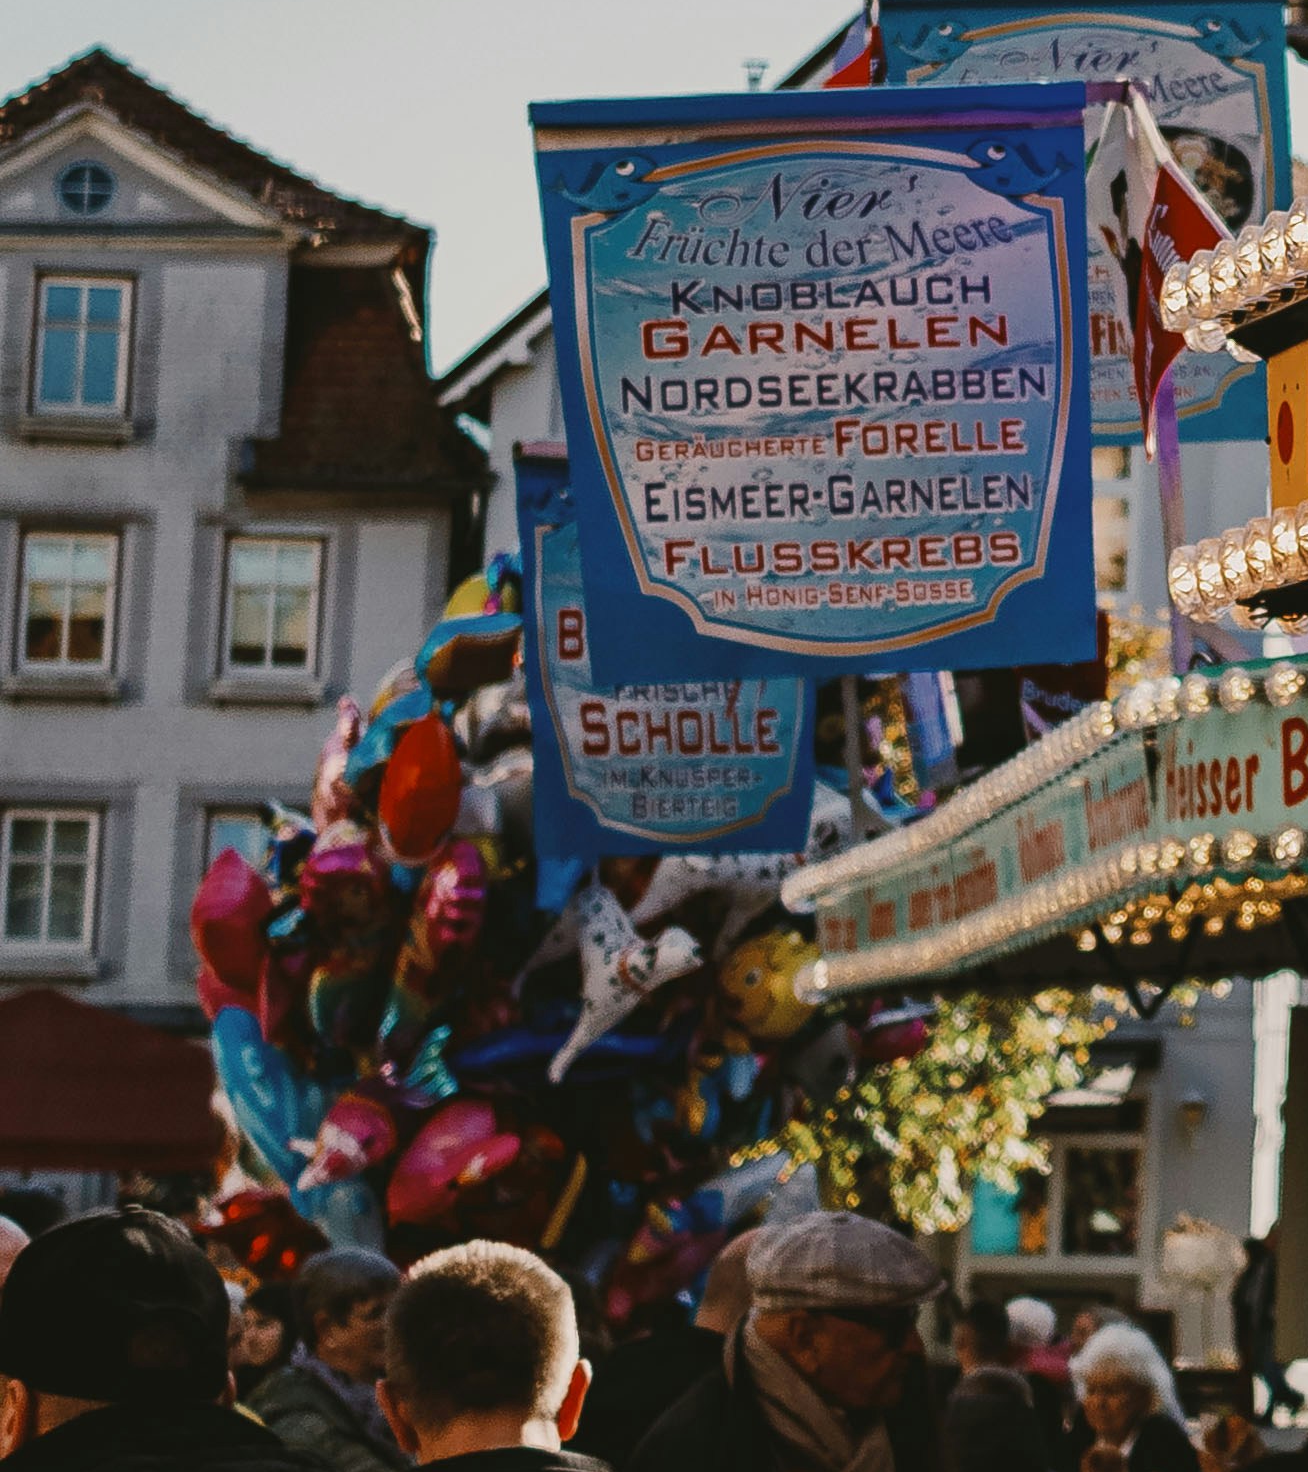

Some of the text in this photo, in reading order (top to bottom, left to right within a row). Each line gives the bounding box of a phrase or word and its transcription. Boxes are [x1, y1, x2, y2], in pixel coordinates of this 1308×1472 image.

[699, 166, 919, 229] Nier's
[629, 213, 1014, 270] Früchte der Meere
[671, 273, 992, 316] KNOBLAUCH
[641, 314, 1010, 361] GARNELEN
[620, 365, 1048, 414] NORDSEEKRABBEN
[635, 418, 1026, 462] GERÄUCHERTE FORELLE
[643, 474, 1033, 524] EISMEER-GARNELEN
[663, 531, 1022, 577] FLUSSKREBS
[712, 579, 973, 610] IN HONIG-SENF-SOSSE
[579, 701, 780, 756] SCHOLLE
[630, 793, 737, 820] BIERTEIG
